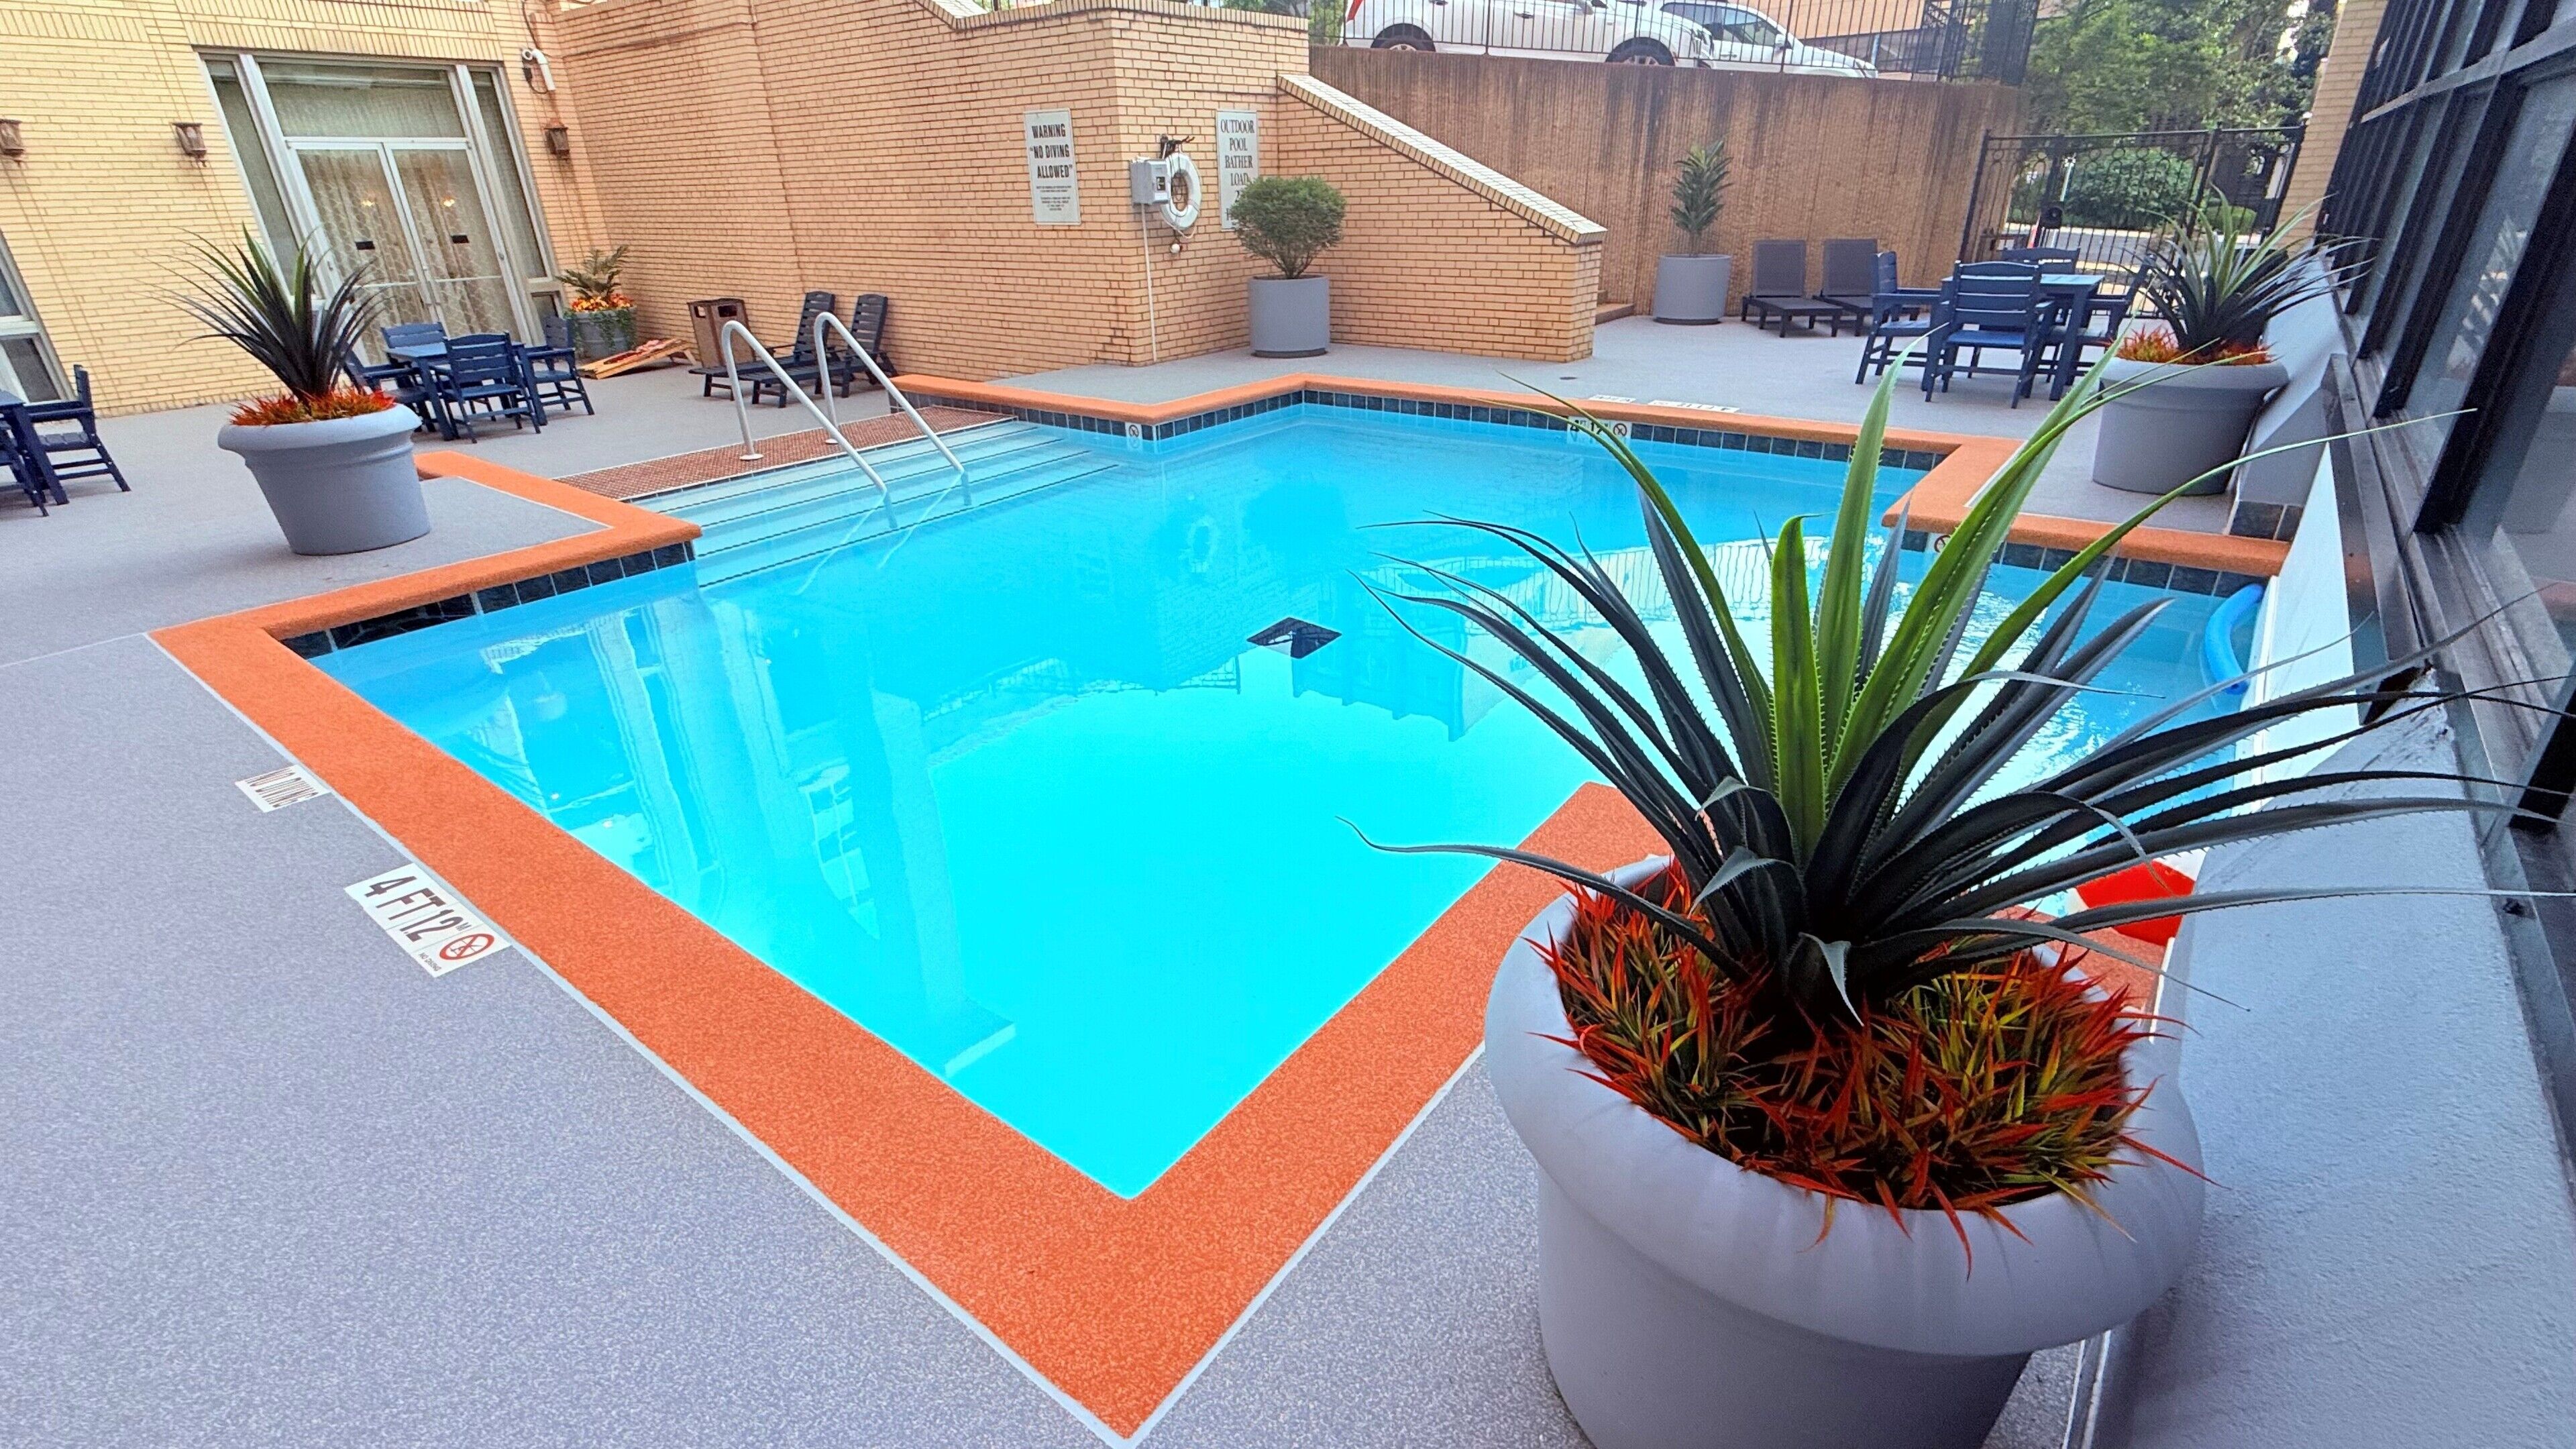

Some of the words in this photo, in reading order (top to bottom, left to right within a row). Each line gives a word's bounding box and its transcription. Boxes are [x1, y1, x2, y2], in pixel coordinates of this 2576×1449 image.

[1032, 123, 1066, 138] WARNING
[1221, 119, 1254, 133] OUTDOOR
[1045, 144, 1069, 158] DIVING
[1229, 138, 1248, 151] POOL
[1225, 155, 1253, 168] BATHER
[1231, 172, 1249, 186] LOAD
[364, 875, 417, 897] 4
[376, 888, 446, 920] FT
